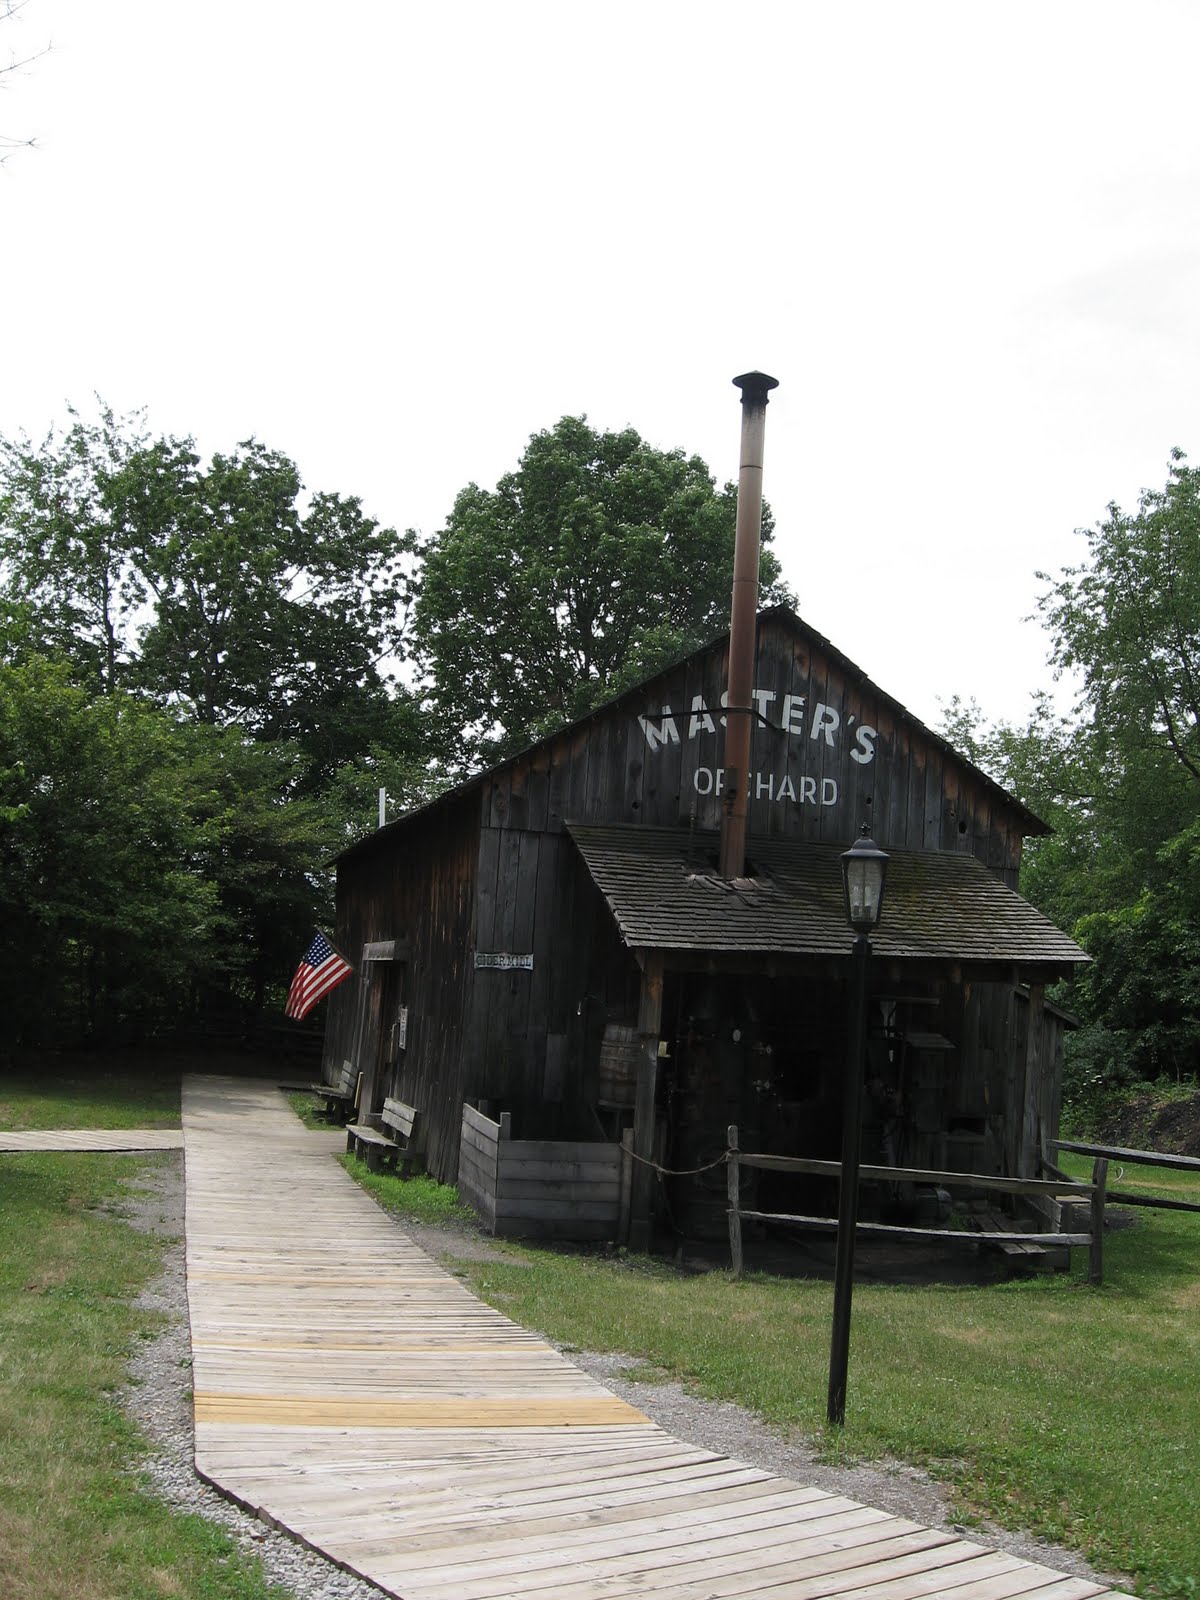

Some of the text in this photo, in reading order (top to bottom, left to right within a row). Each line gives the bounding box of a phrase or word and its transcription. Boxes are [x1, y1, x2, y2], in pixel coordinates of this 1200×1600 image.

[637, 688, 878, 765] MATER'S
[693, 767, 838, 806] OHARD
[476, 954, 532, 967] CIDER MILL
